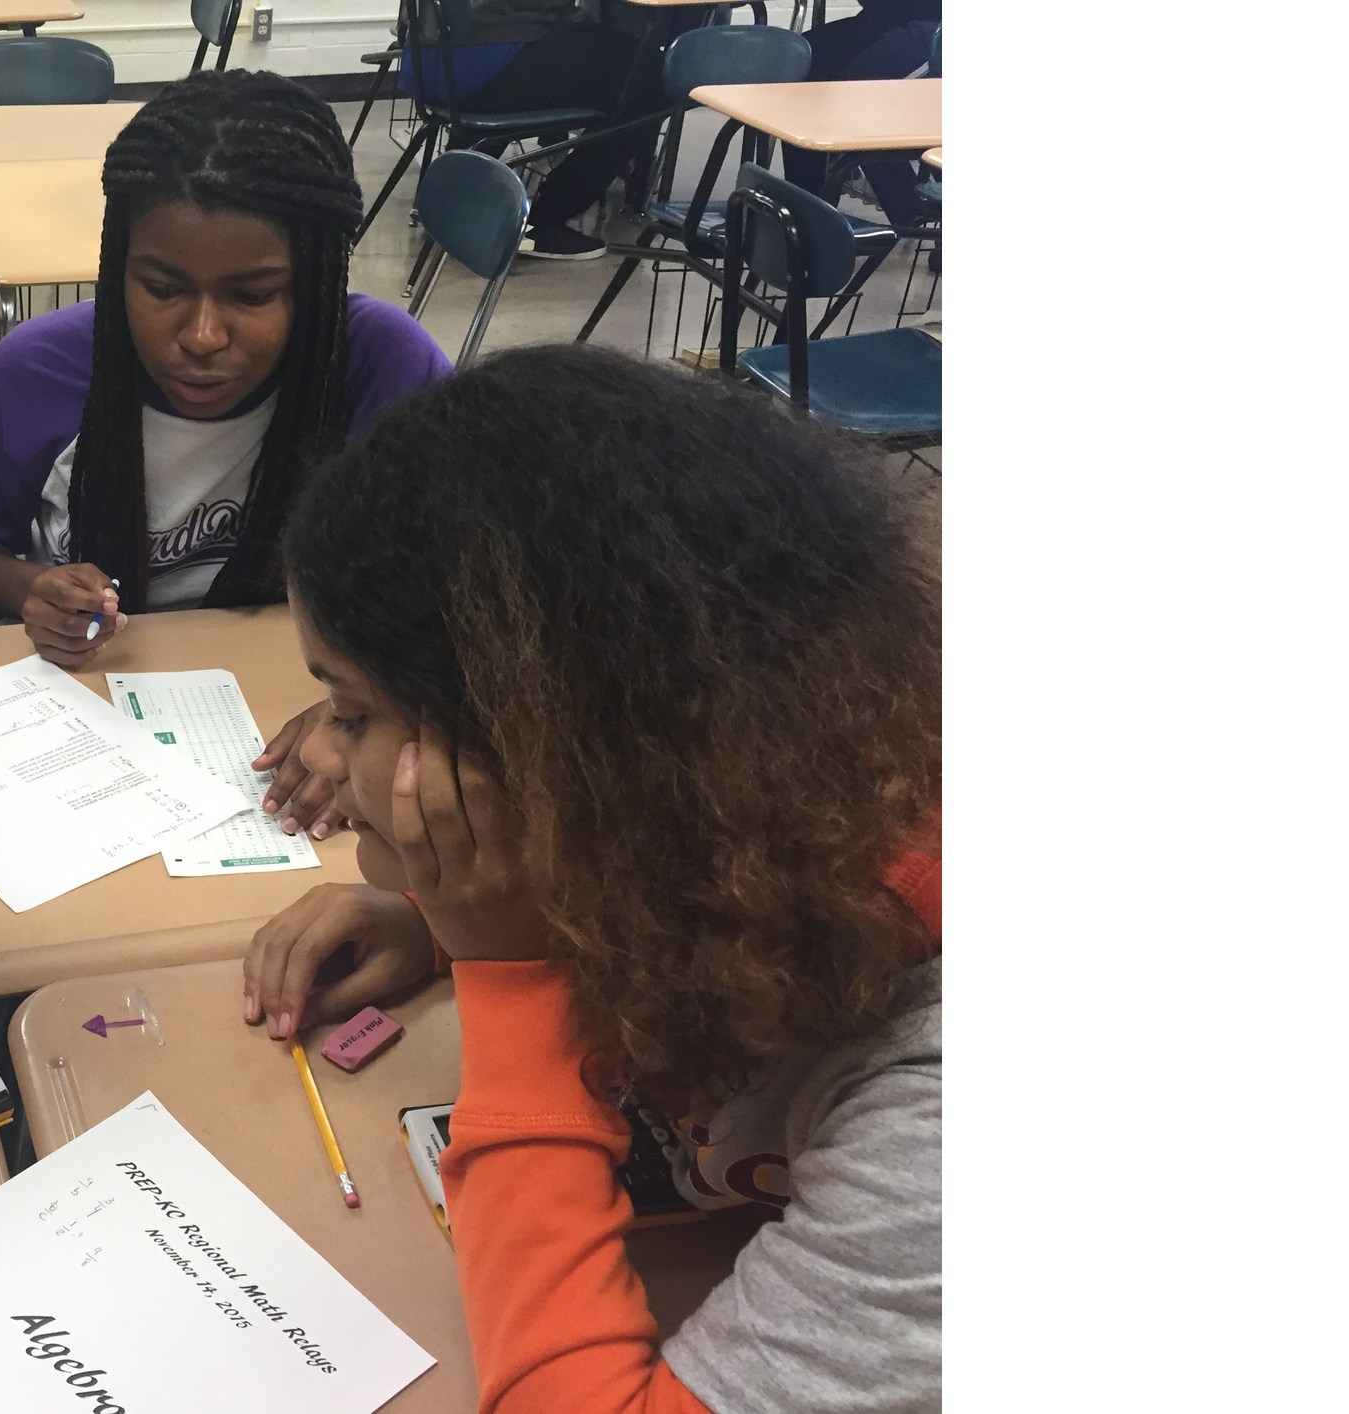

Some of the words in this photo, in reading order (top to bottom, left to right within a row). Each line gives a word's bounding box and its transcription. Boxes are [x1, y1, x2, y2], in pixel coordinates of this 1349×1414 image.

[339, 1031, 367, 1051] Eraser
[364, 1016, 384, 1032] Pink
[115, 1161, 186, 1220] PREP-KC
[178, 1224, 248, 1281] Regional
[239, 1284, 288, 1323] Math
[282, 1327, 338, 1375] Relays
[144, 1228, 199, 1279] November
[196, 1281, 218, 1298] 14,
[215, 1301, 253, 1329] 2015
